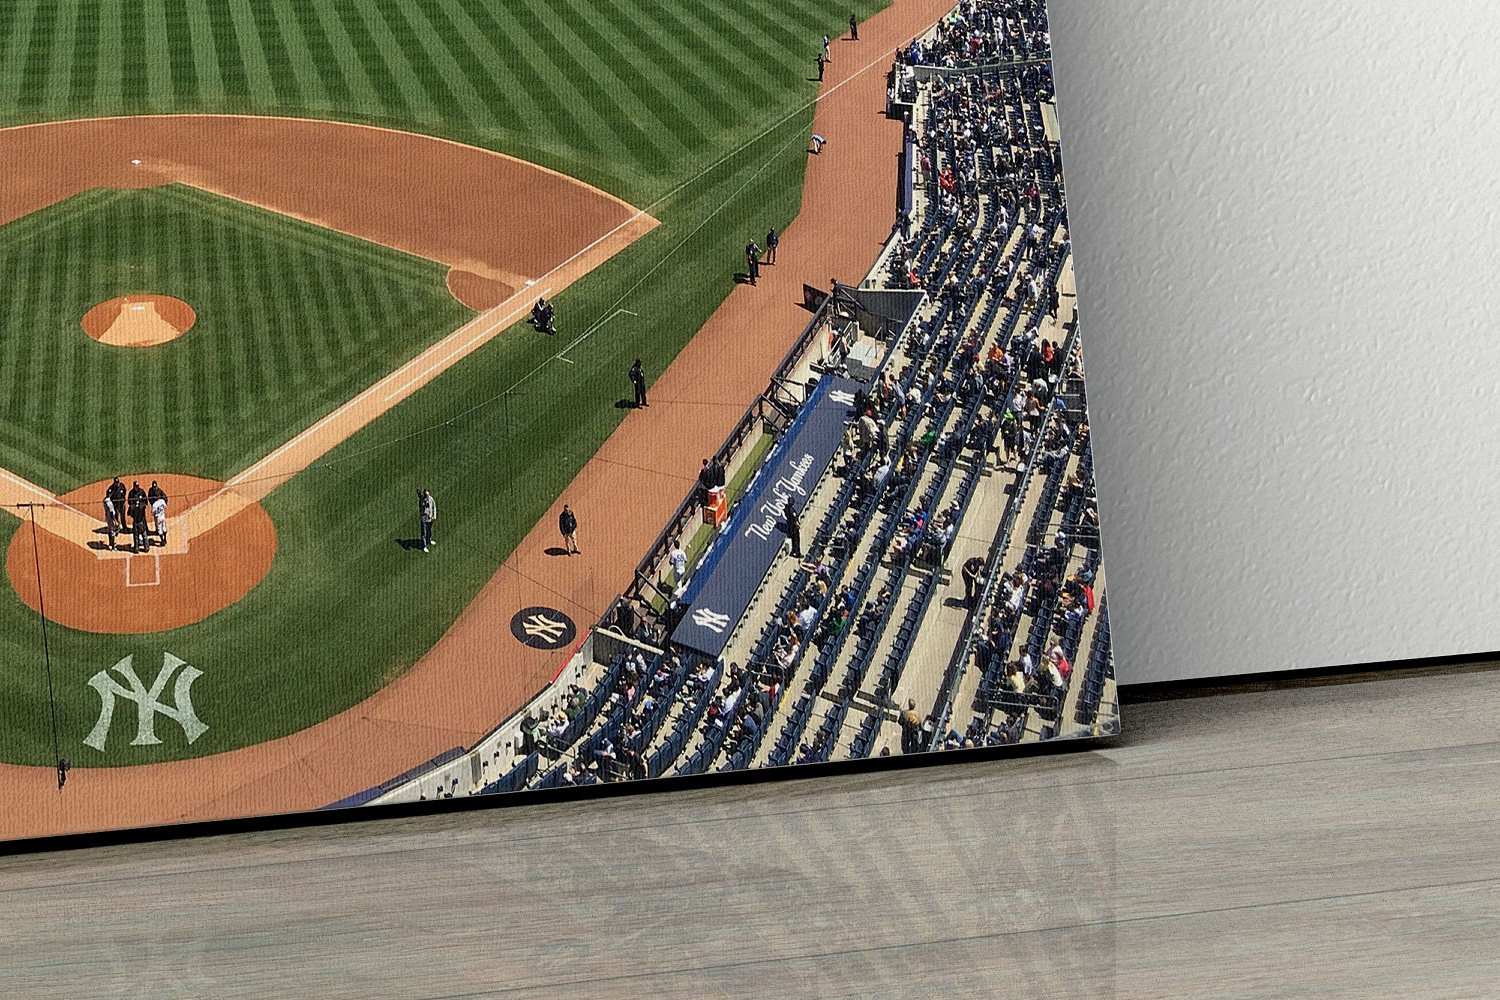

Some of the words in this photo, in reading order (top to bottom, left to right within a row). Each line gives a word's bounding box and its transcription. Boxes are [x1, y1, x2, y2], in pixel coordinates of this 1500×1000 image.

[776, 453, 815, 497] Yankees
[760, 487, 792, 521] York
[744, 514, 777, 541] New
